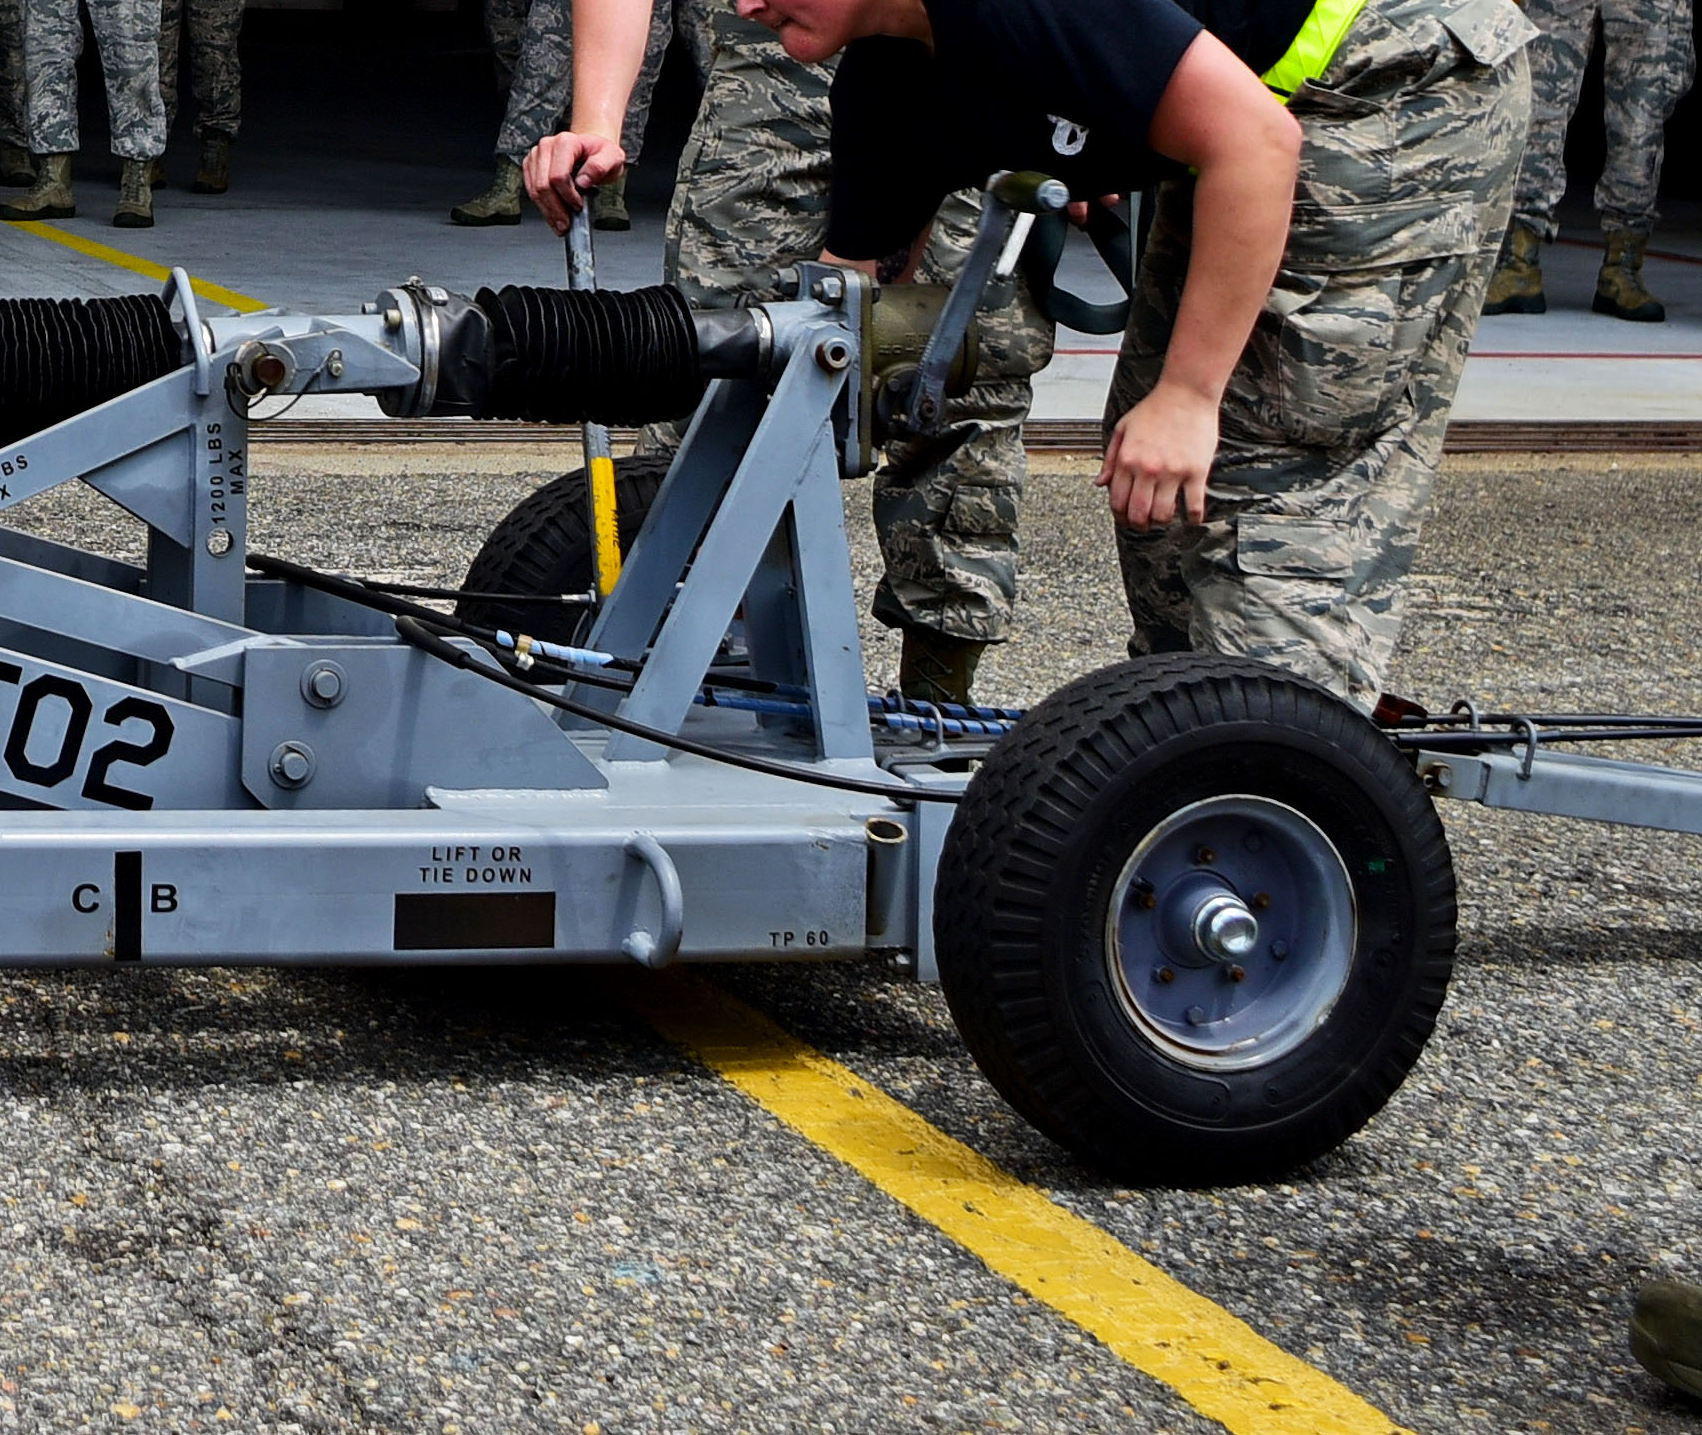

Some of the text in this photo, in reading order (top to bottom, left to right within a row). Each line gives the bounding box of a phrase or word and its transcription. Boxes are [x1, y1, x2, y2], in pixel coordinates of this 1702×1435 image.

[207, 423, 226, 524] 1200 LBS
[228, 449, 244, 495] MAX
[432, 846, 522, 862] LIFT OR
[419, 867, 532, 883] TIE DOWN
[72, 883, 178, 914] C B
[769, 930, 829, 947] TP 60
